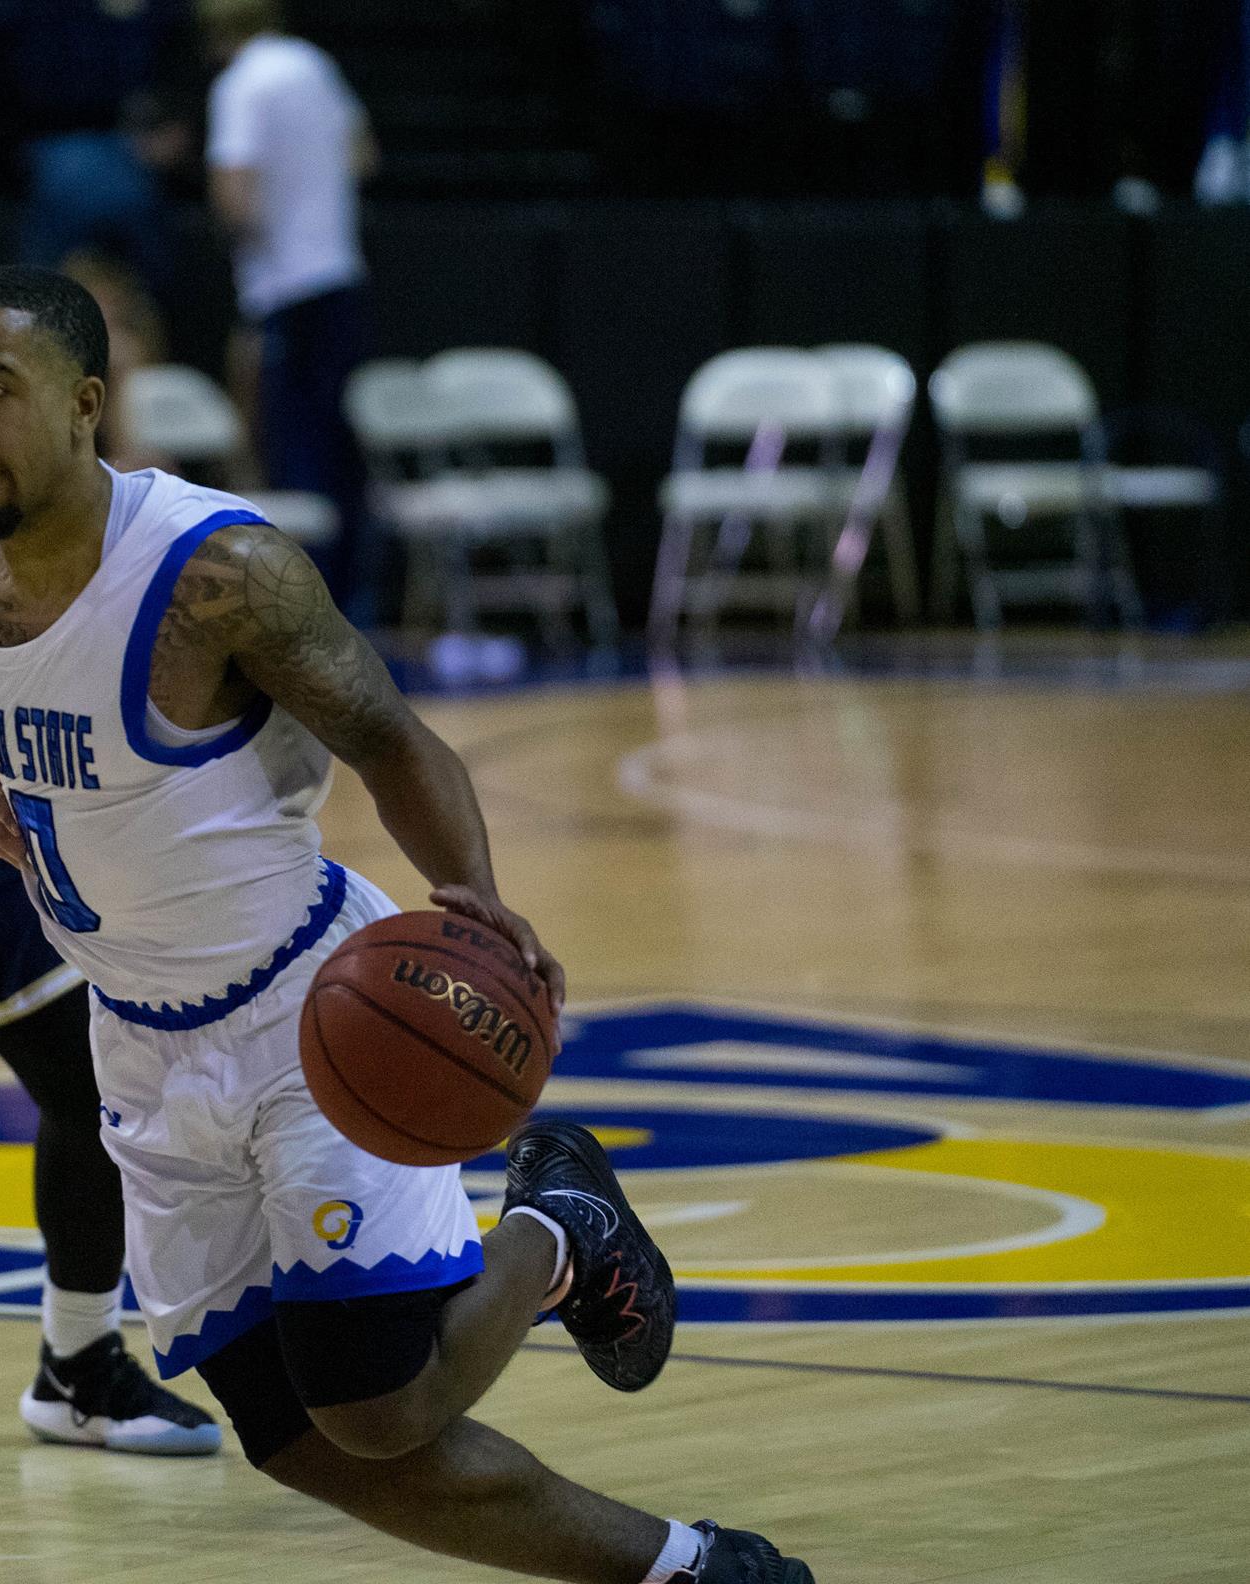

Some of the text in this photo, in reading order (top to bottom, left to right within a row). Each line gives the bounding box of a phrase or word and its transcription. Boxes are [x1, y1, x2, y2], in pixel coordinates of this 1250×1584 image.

[14, 706, 101, 790] STATE
[8, 787, 102, 933] 0
[391, 958, 532, 1078] Wilson
